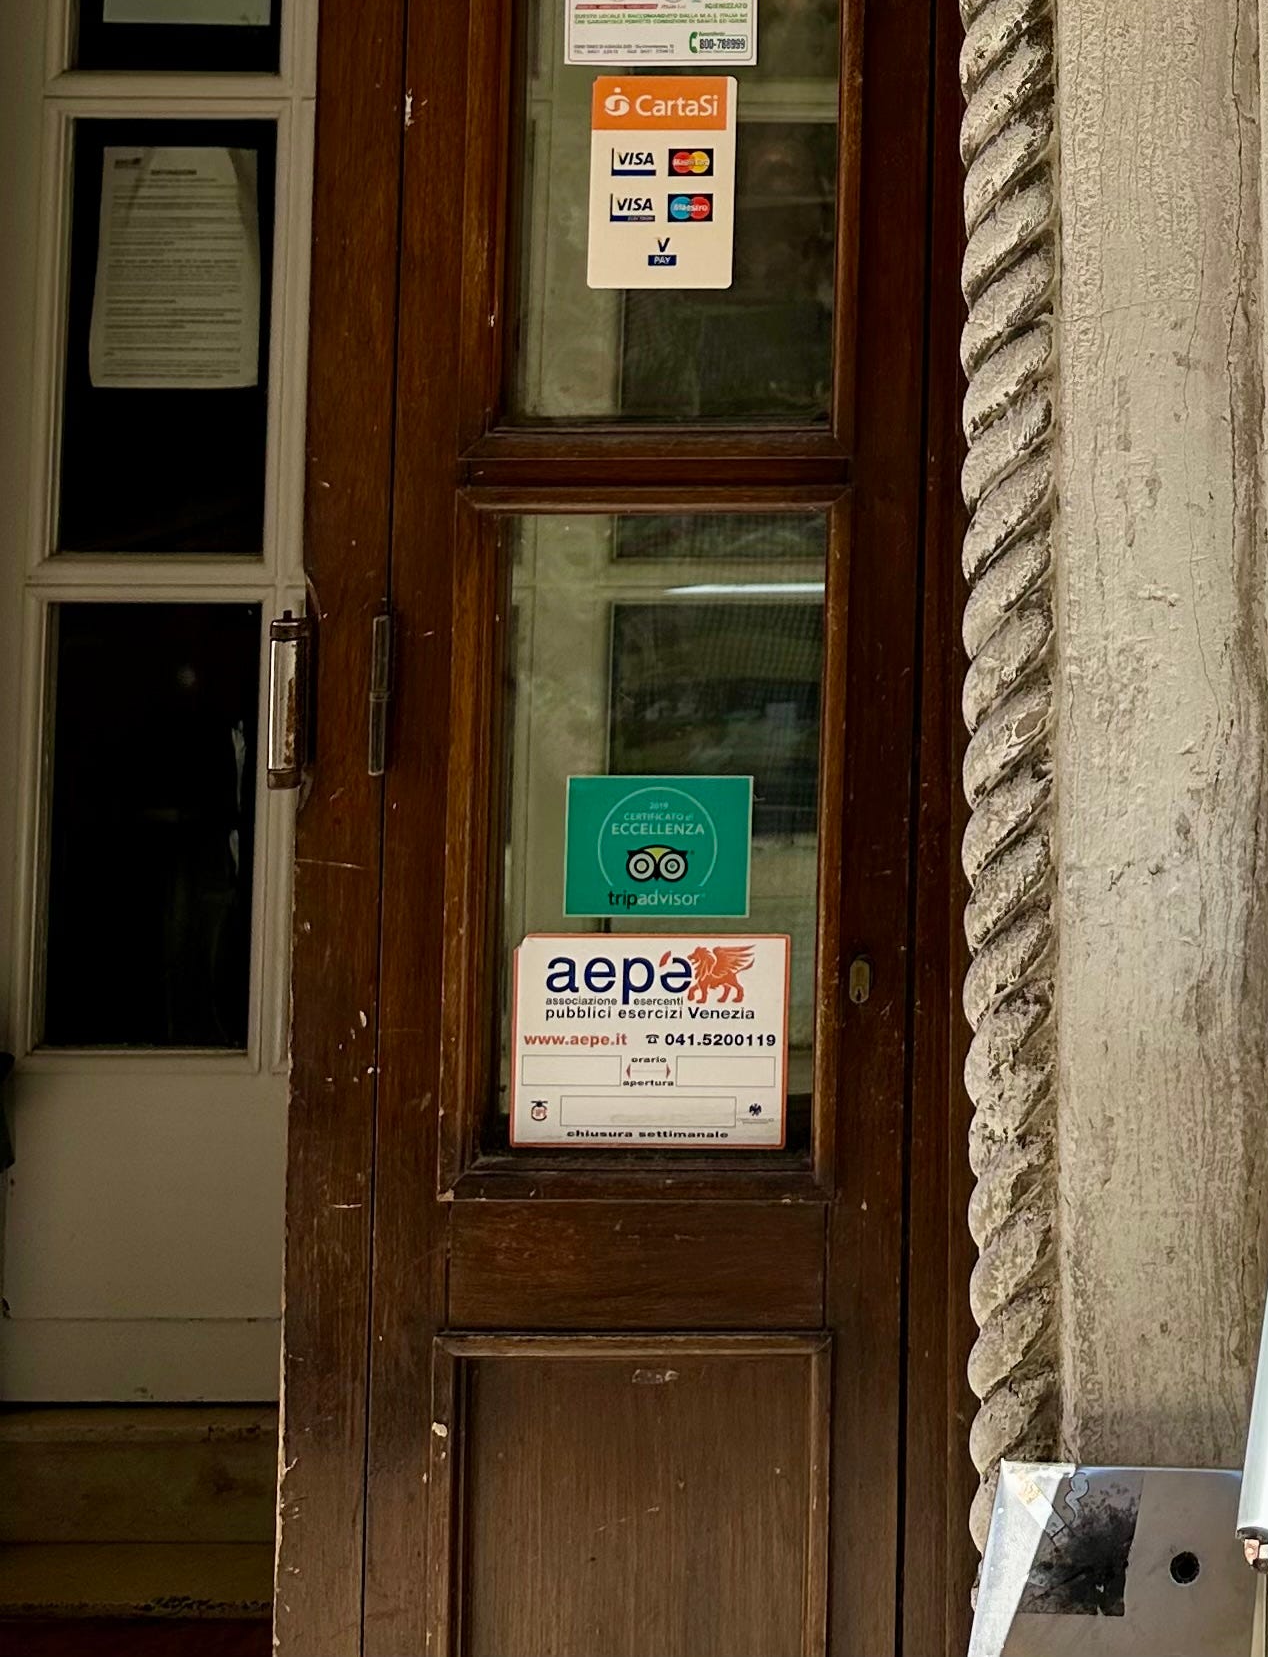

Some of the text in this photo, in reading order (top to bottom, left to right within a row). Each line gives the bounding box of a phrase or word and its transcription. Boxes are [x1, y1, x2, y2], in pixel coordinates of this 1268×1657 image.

[635, 95, 719, 116] CartaSi
[617, 152, 654, 165] VISA
[617, 198, 708, 212] VISA Maestro
[657, 237, 670, 252] V
[624, 813, 684, 821] CERTIFICATO
[611, 824, 704, 835] ECCELLENZA
[608, 890, 699, 909] tripadvisor
[545, 996, 684, 1005] associazione esercenti
[545, 1006, 755, 1021] pubblici esercizi Venezia
[524, 1033, 776, 1048] www.aepe.it 041.5200119
[631, 1056, 667, 1064] orario
[623, 1079, 674, 1088] apertura
[567, 1130, 729, 1139] chiusura settimanale
